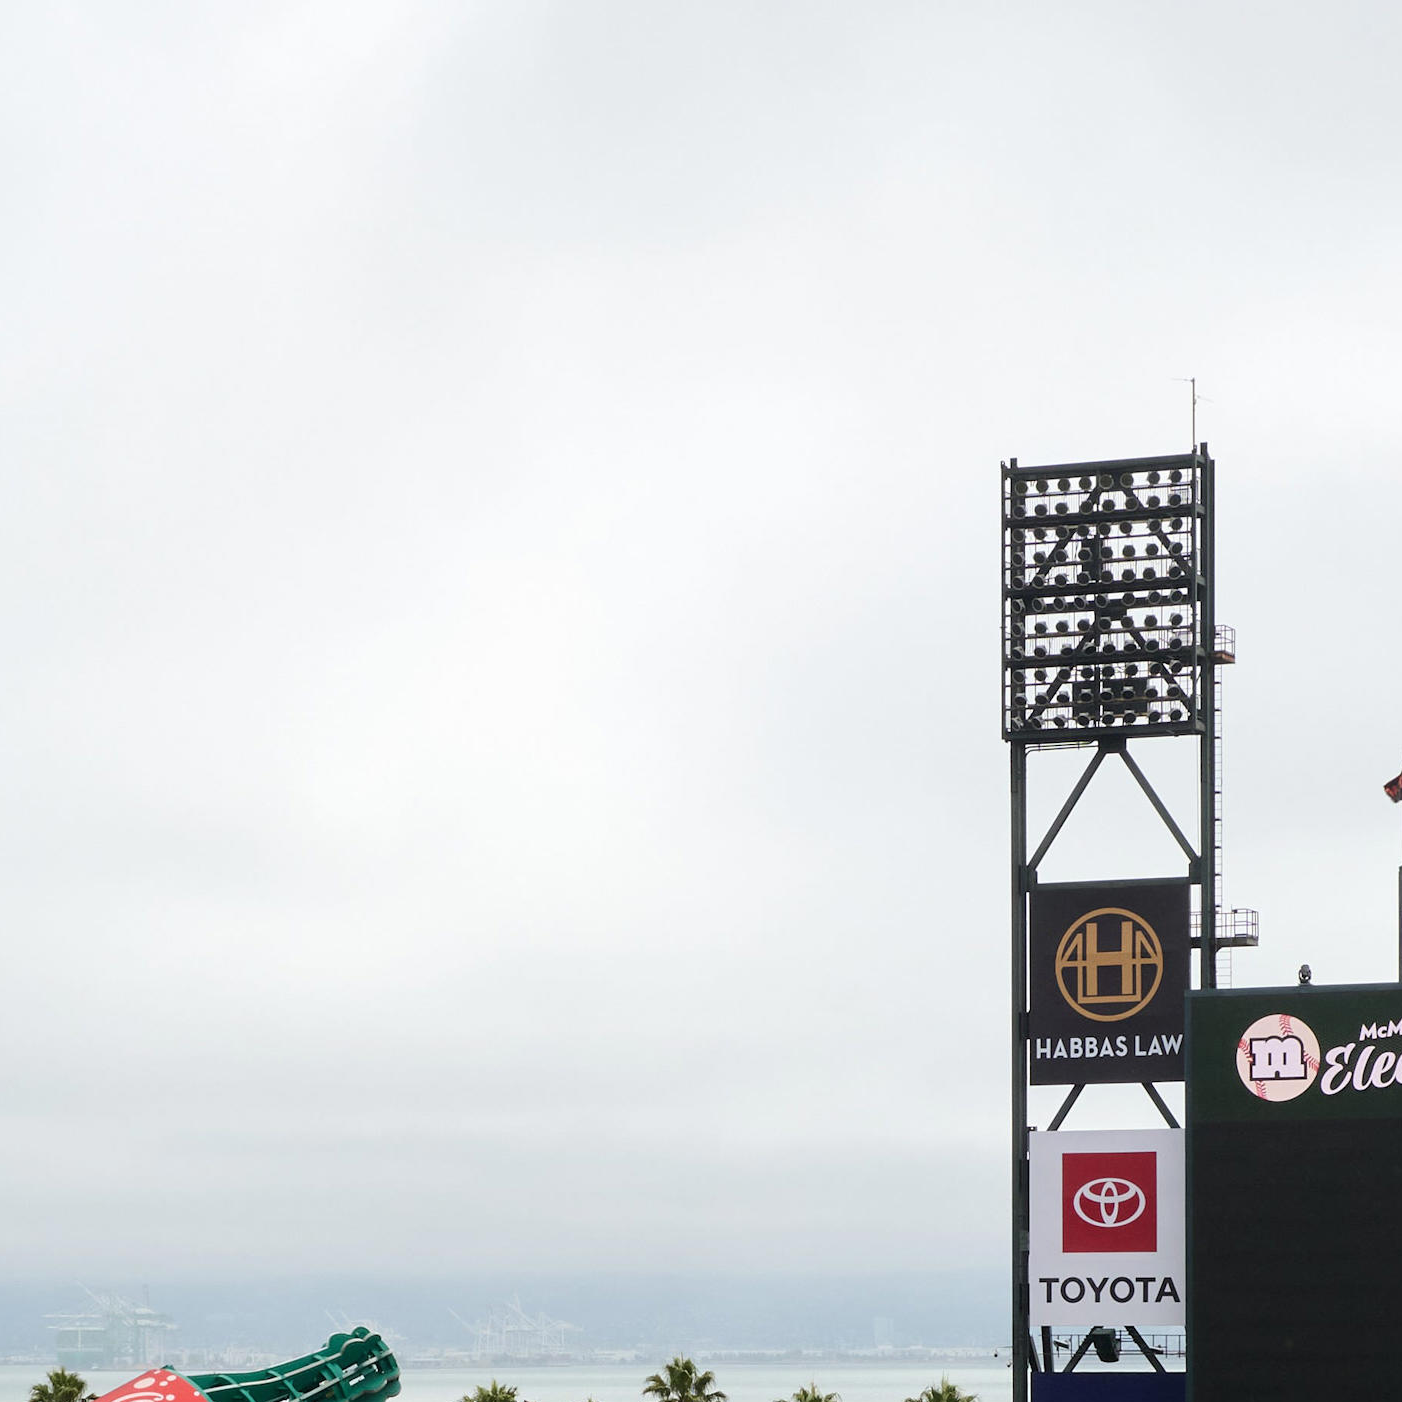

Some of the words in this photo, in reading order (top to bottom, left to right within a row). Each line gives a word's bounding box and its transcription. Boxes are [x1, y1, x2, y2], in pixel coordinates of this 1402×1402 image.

[1036, 1036, 1128, 1059] HABBAS
[1135, 1034, 1183, 1057] LAW
[1039, 1276, 1181, 1303] TOYOTA
